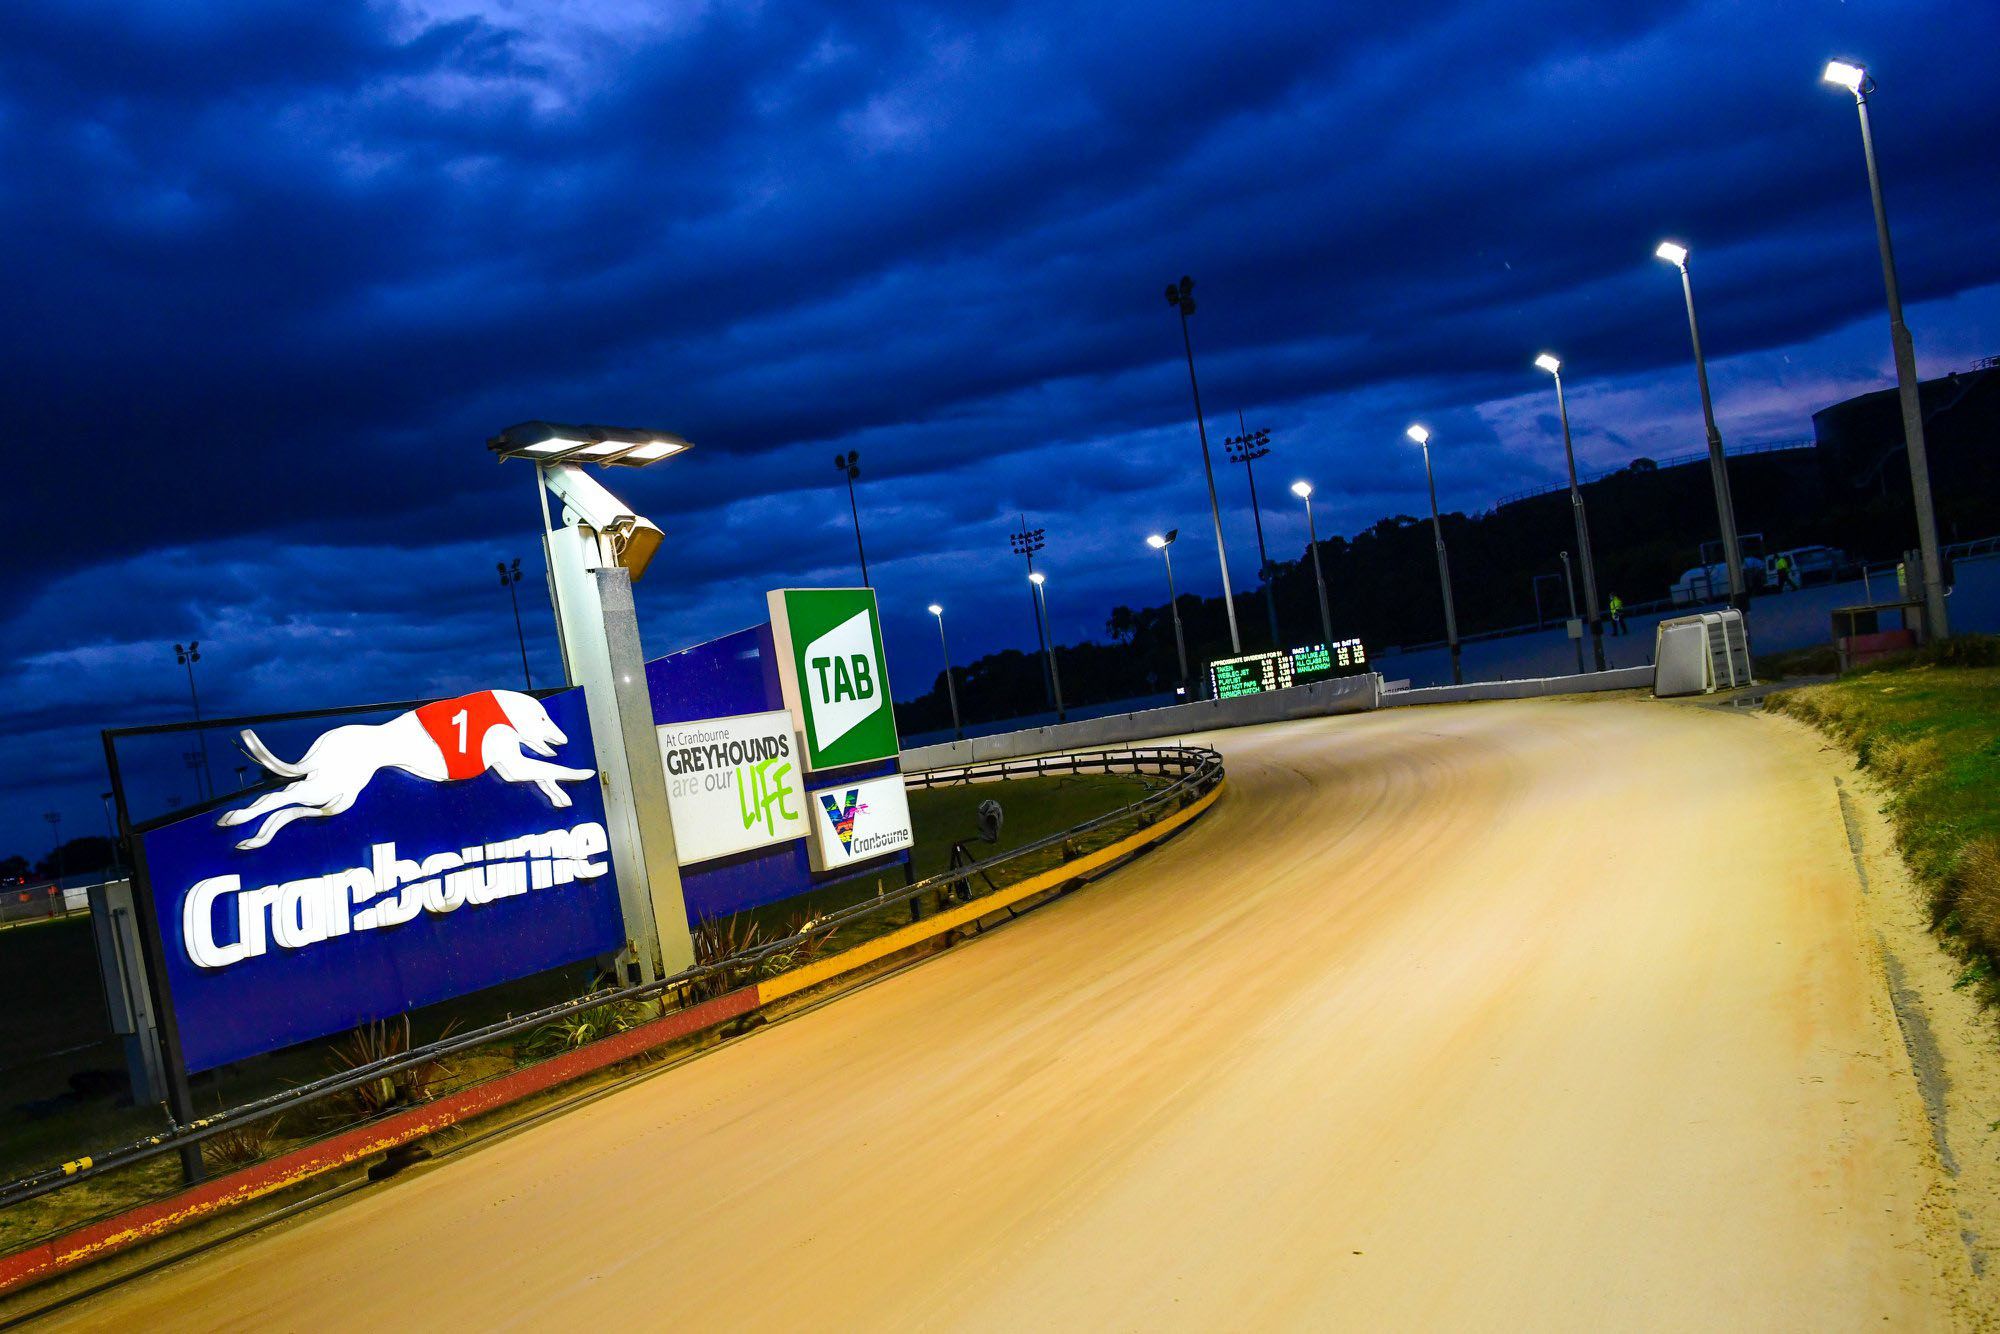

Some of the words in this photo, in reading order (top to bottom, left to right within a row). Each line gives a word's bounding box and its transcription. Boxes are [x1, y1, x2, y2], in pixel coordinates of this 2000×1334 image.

[812, 654, 874, 704] TAB
[451, 708, 469, 755] 1
[666, 731, 676, 746] At
[678, 728, 730, 746] Cranbourne
[667, 734, 789, 775] GREYHOUNDS
[672, 776, 698, 798] are
[705, 768, 732, 791] our
[736, 757, 798, 836] LIFE
[853, 827, 909, 854] Cranbourne
[182, 822, 609, 969] Cranbourne
